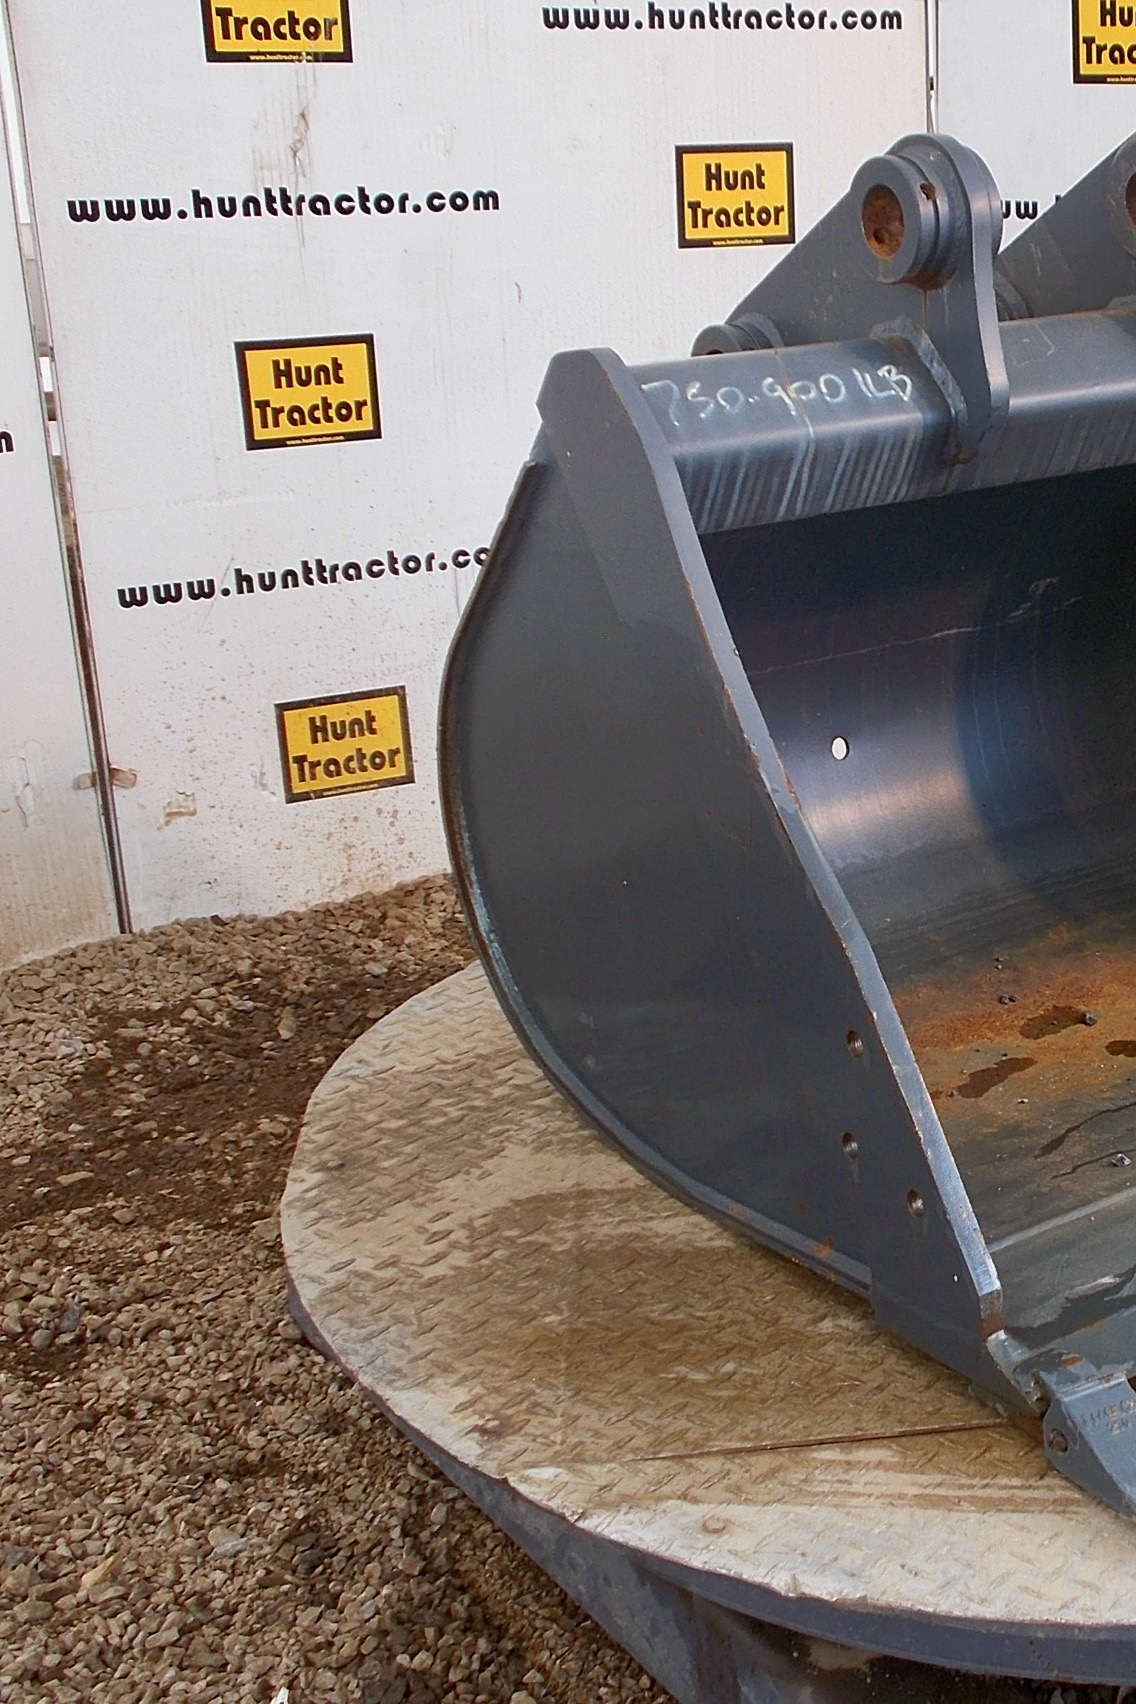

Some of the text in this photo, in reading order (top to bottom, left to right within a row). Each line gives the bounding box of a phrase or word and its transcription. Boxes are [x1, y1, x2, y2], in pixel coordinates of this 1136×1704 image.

[215, 7, 338, 41] Tractor
[542, 1, 902, 30] www.hunttractor.com
[705, 163, 766, 191] Hunt
[66, 186, 500, 223] www.hunttractor.com
[687, 201, 785, 229] Tractor
[272, 357, 344, 389] Hunt
[254, 396, 368, 429] Tractor
[117, 546, 490, 609] www.hunttractor.co
[308, 709, 378, 745] Hunt
[292, 747, 401, 783] Tractor
